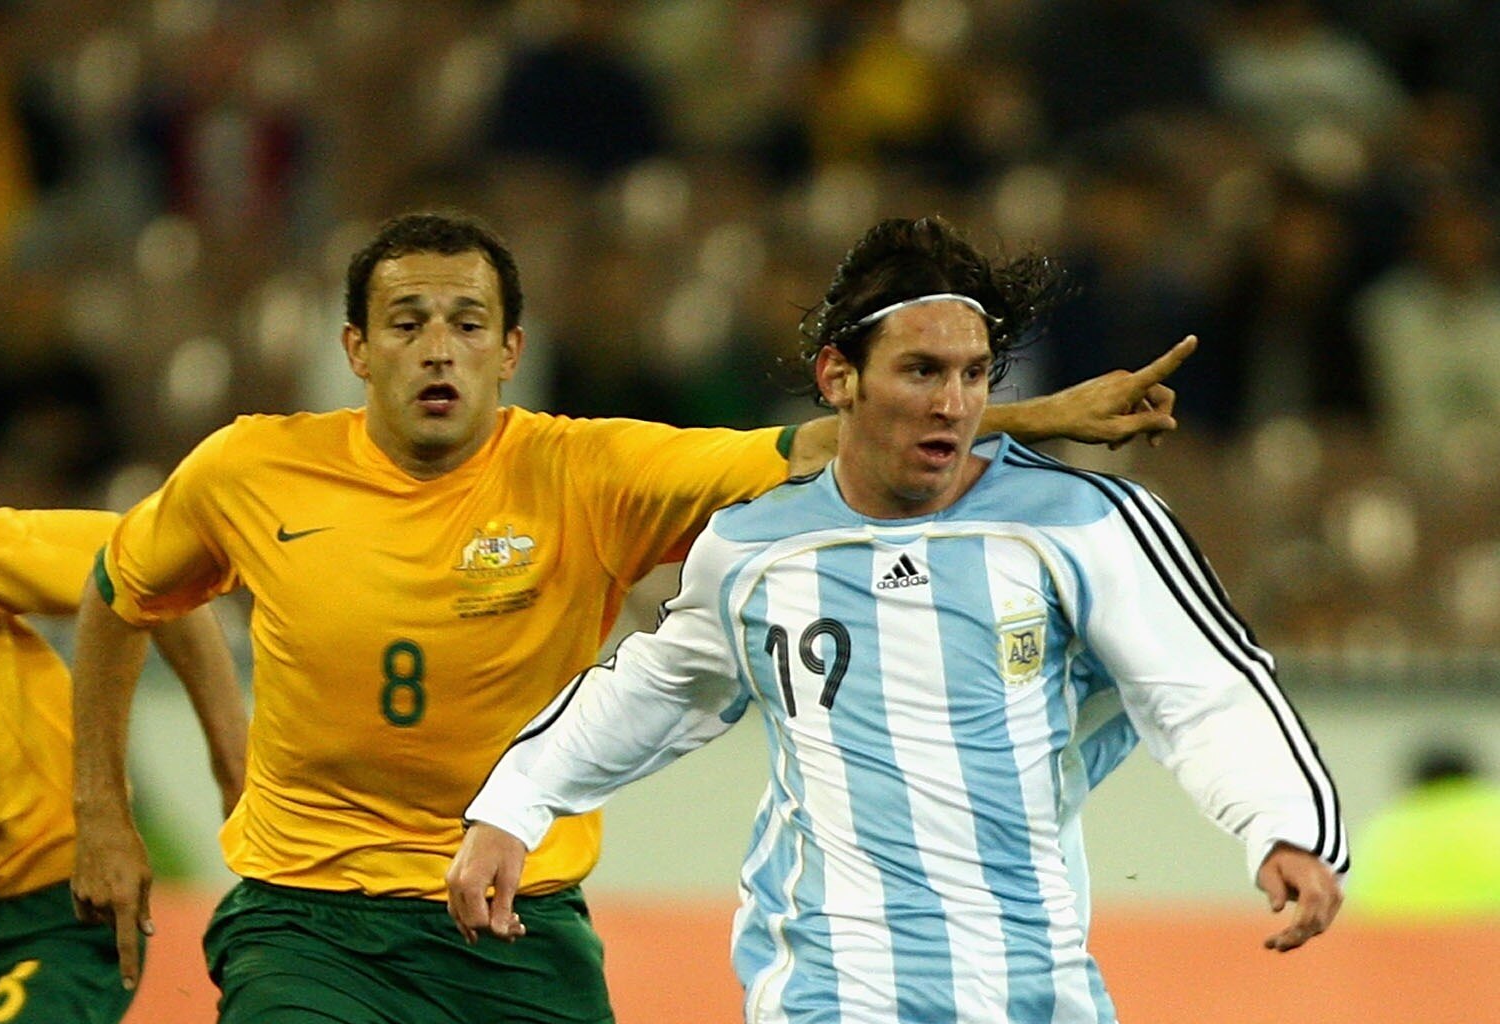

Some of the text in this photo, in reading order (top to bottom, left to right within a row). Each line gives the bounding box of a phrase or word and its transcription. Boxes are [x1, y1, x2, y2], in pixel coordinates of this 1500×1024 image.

[876, 574, 929, 590] adidas
[380, 638, 427, 727] 8
[764, 617, 852, 718] 19
